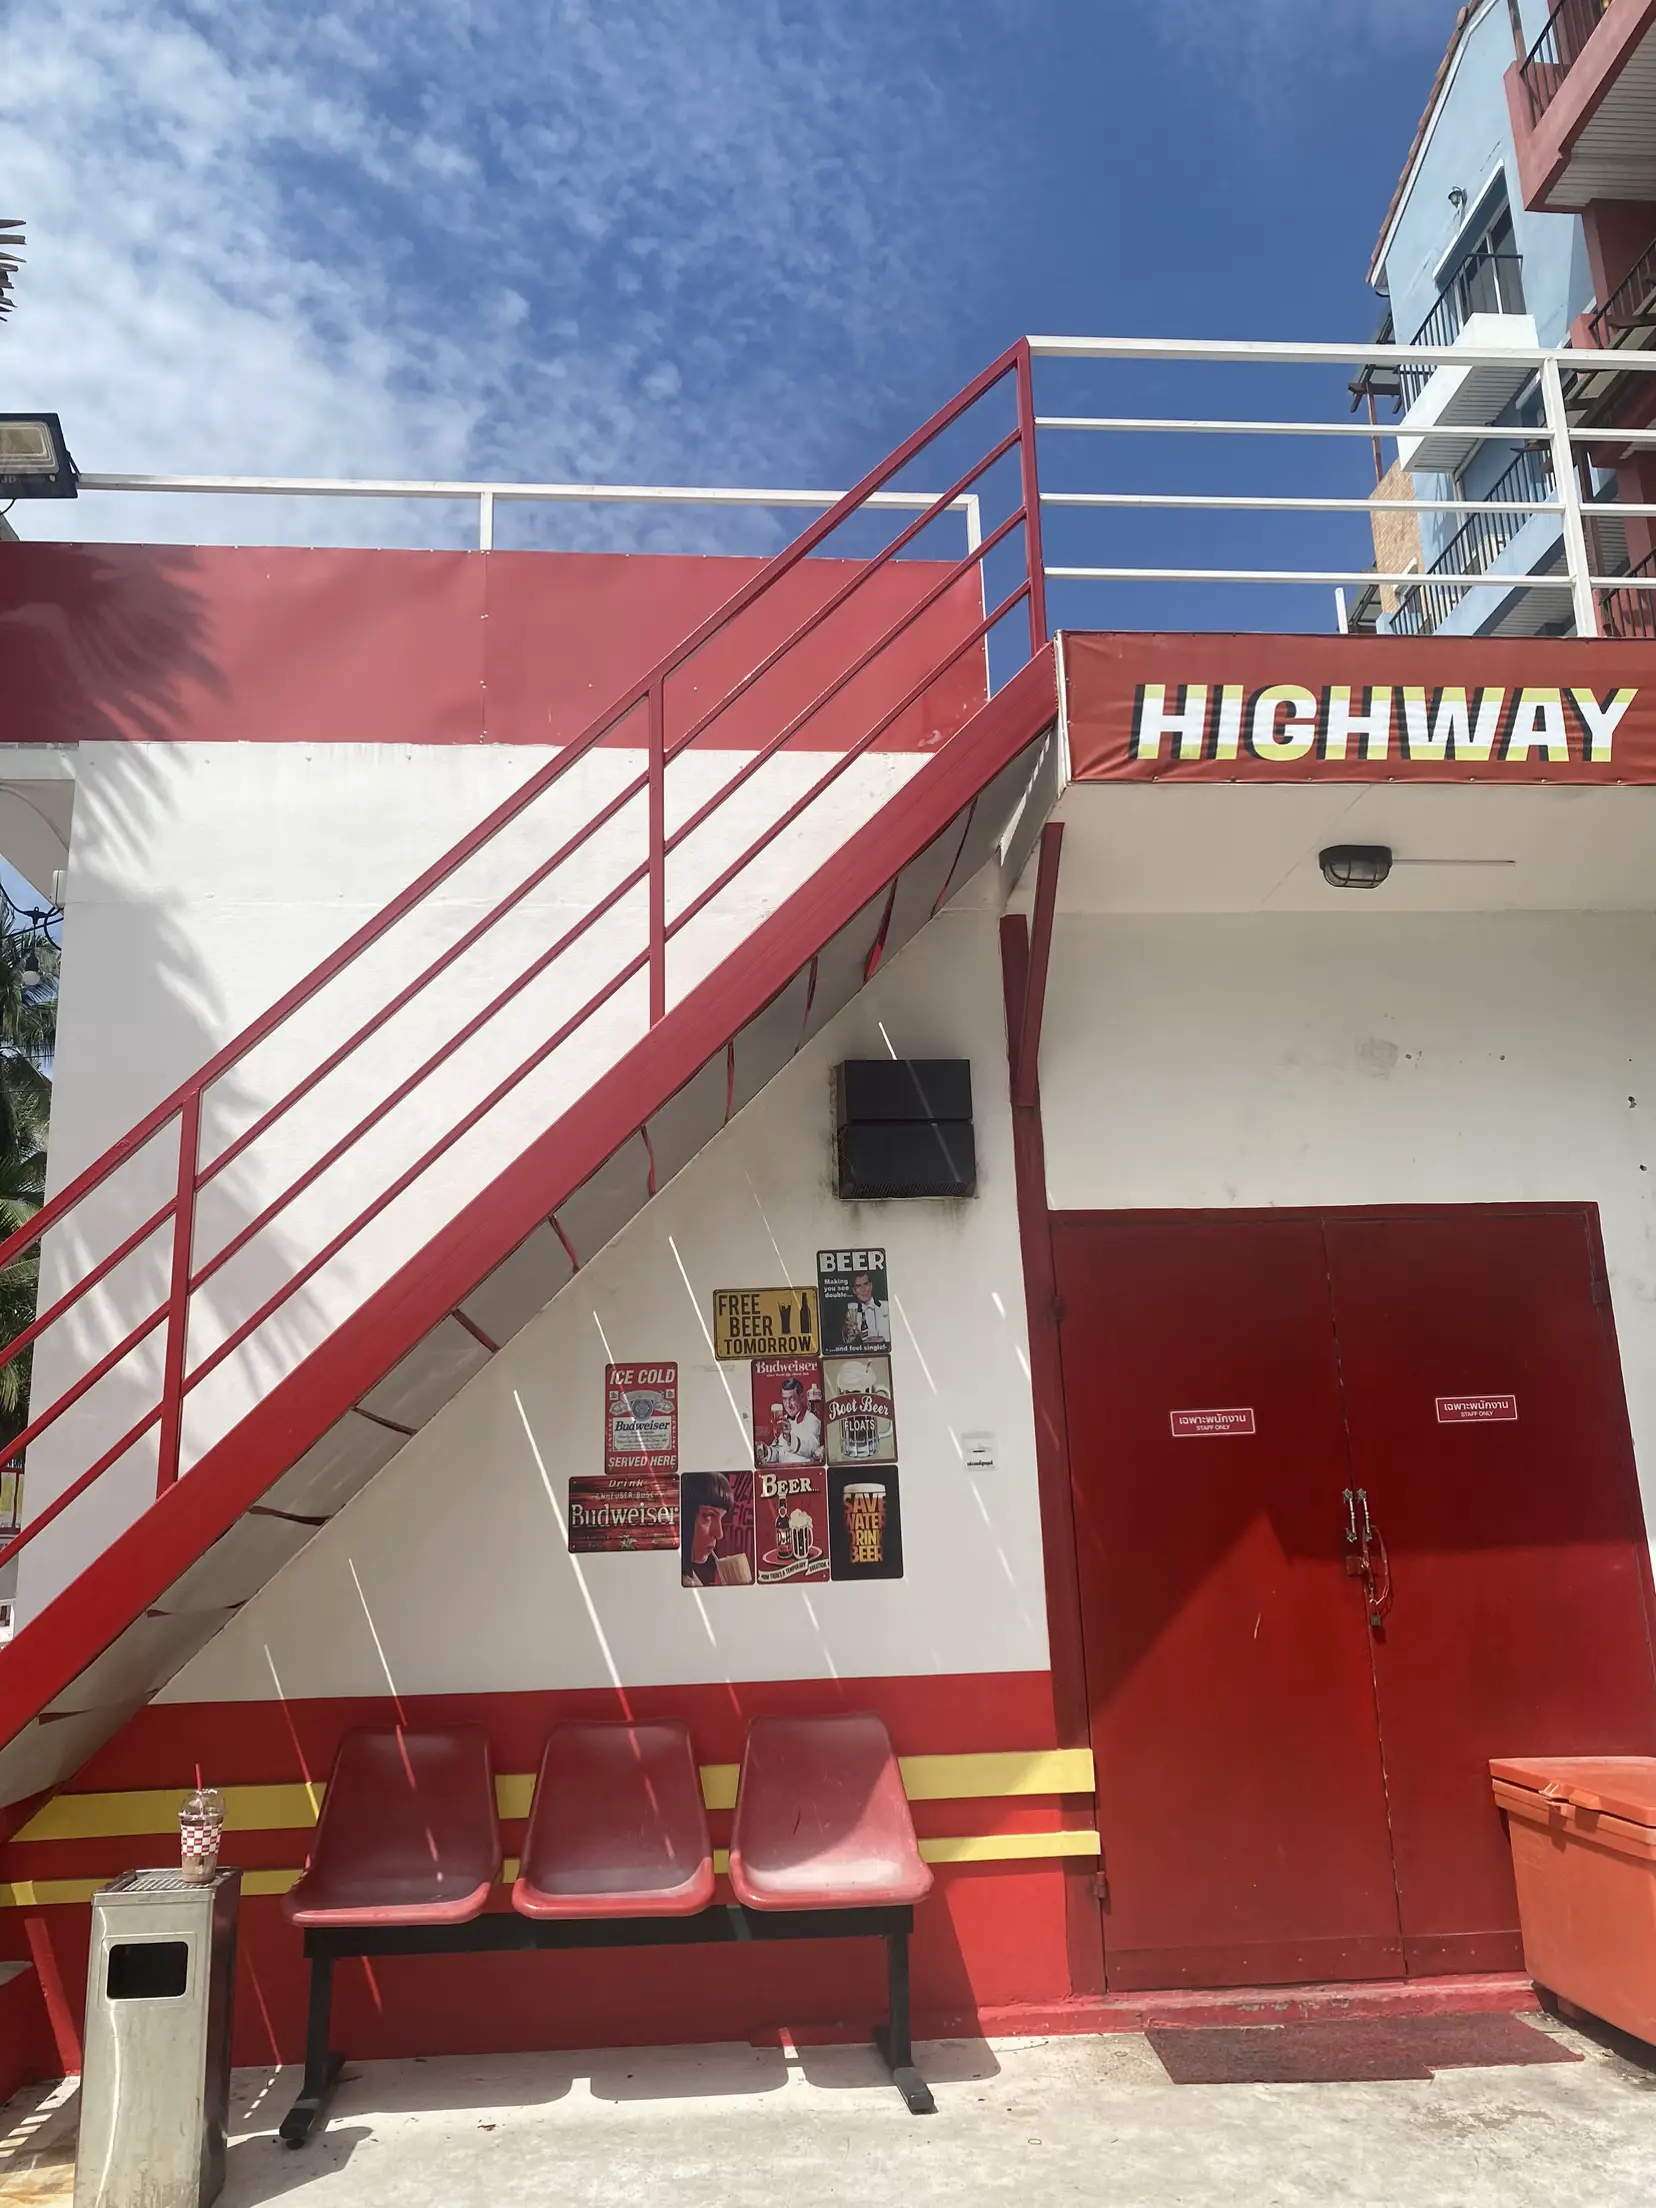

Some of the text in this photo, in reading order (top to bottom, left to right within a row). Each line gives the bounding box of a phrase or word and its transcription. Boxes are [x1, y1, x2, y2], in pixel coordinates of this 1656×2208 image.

[1129, 684, 1639, 762] HIGHWAY
[820, 1250, 885, 1272] BEER
[718, 1294, 760, 1316] FREE
[729, 1315, 773, 1337] BEER
[724, 1336, 811, 1354] TOMORROW
[755, 1360, 818, 1374] Budweiser
[610, 1369, 675, 1384] ICE COLD
[829, 1395, 889, 1420] Root Beer
[1443, 1400, 1509, 1411] เฉพาะพนักงาน
[614, 1420, 670, 1431] Budweiser
[844, 1419, 875, 1431] FLOATS
[1178, 1413, 1247, 1424] เฉพาะพนักงาน
[608, 1455, 676, 1467] SERVED HERE
[842, 1492, 887, 1513] SAVE
[571, 1502, 679, 1526] Budweiser
[850, 1545, 884, 1564] BEER
